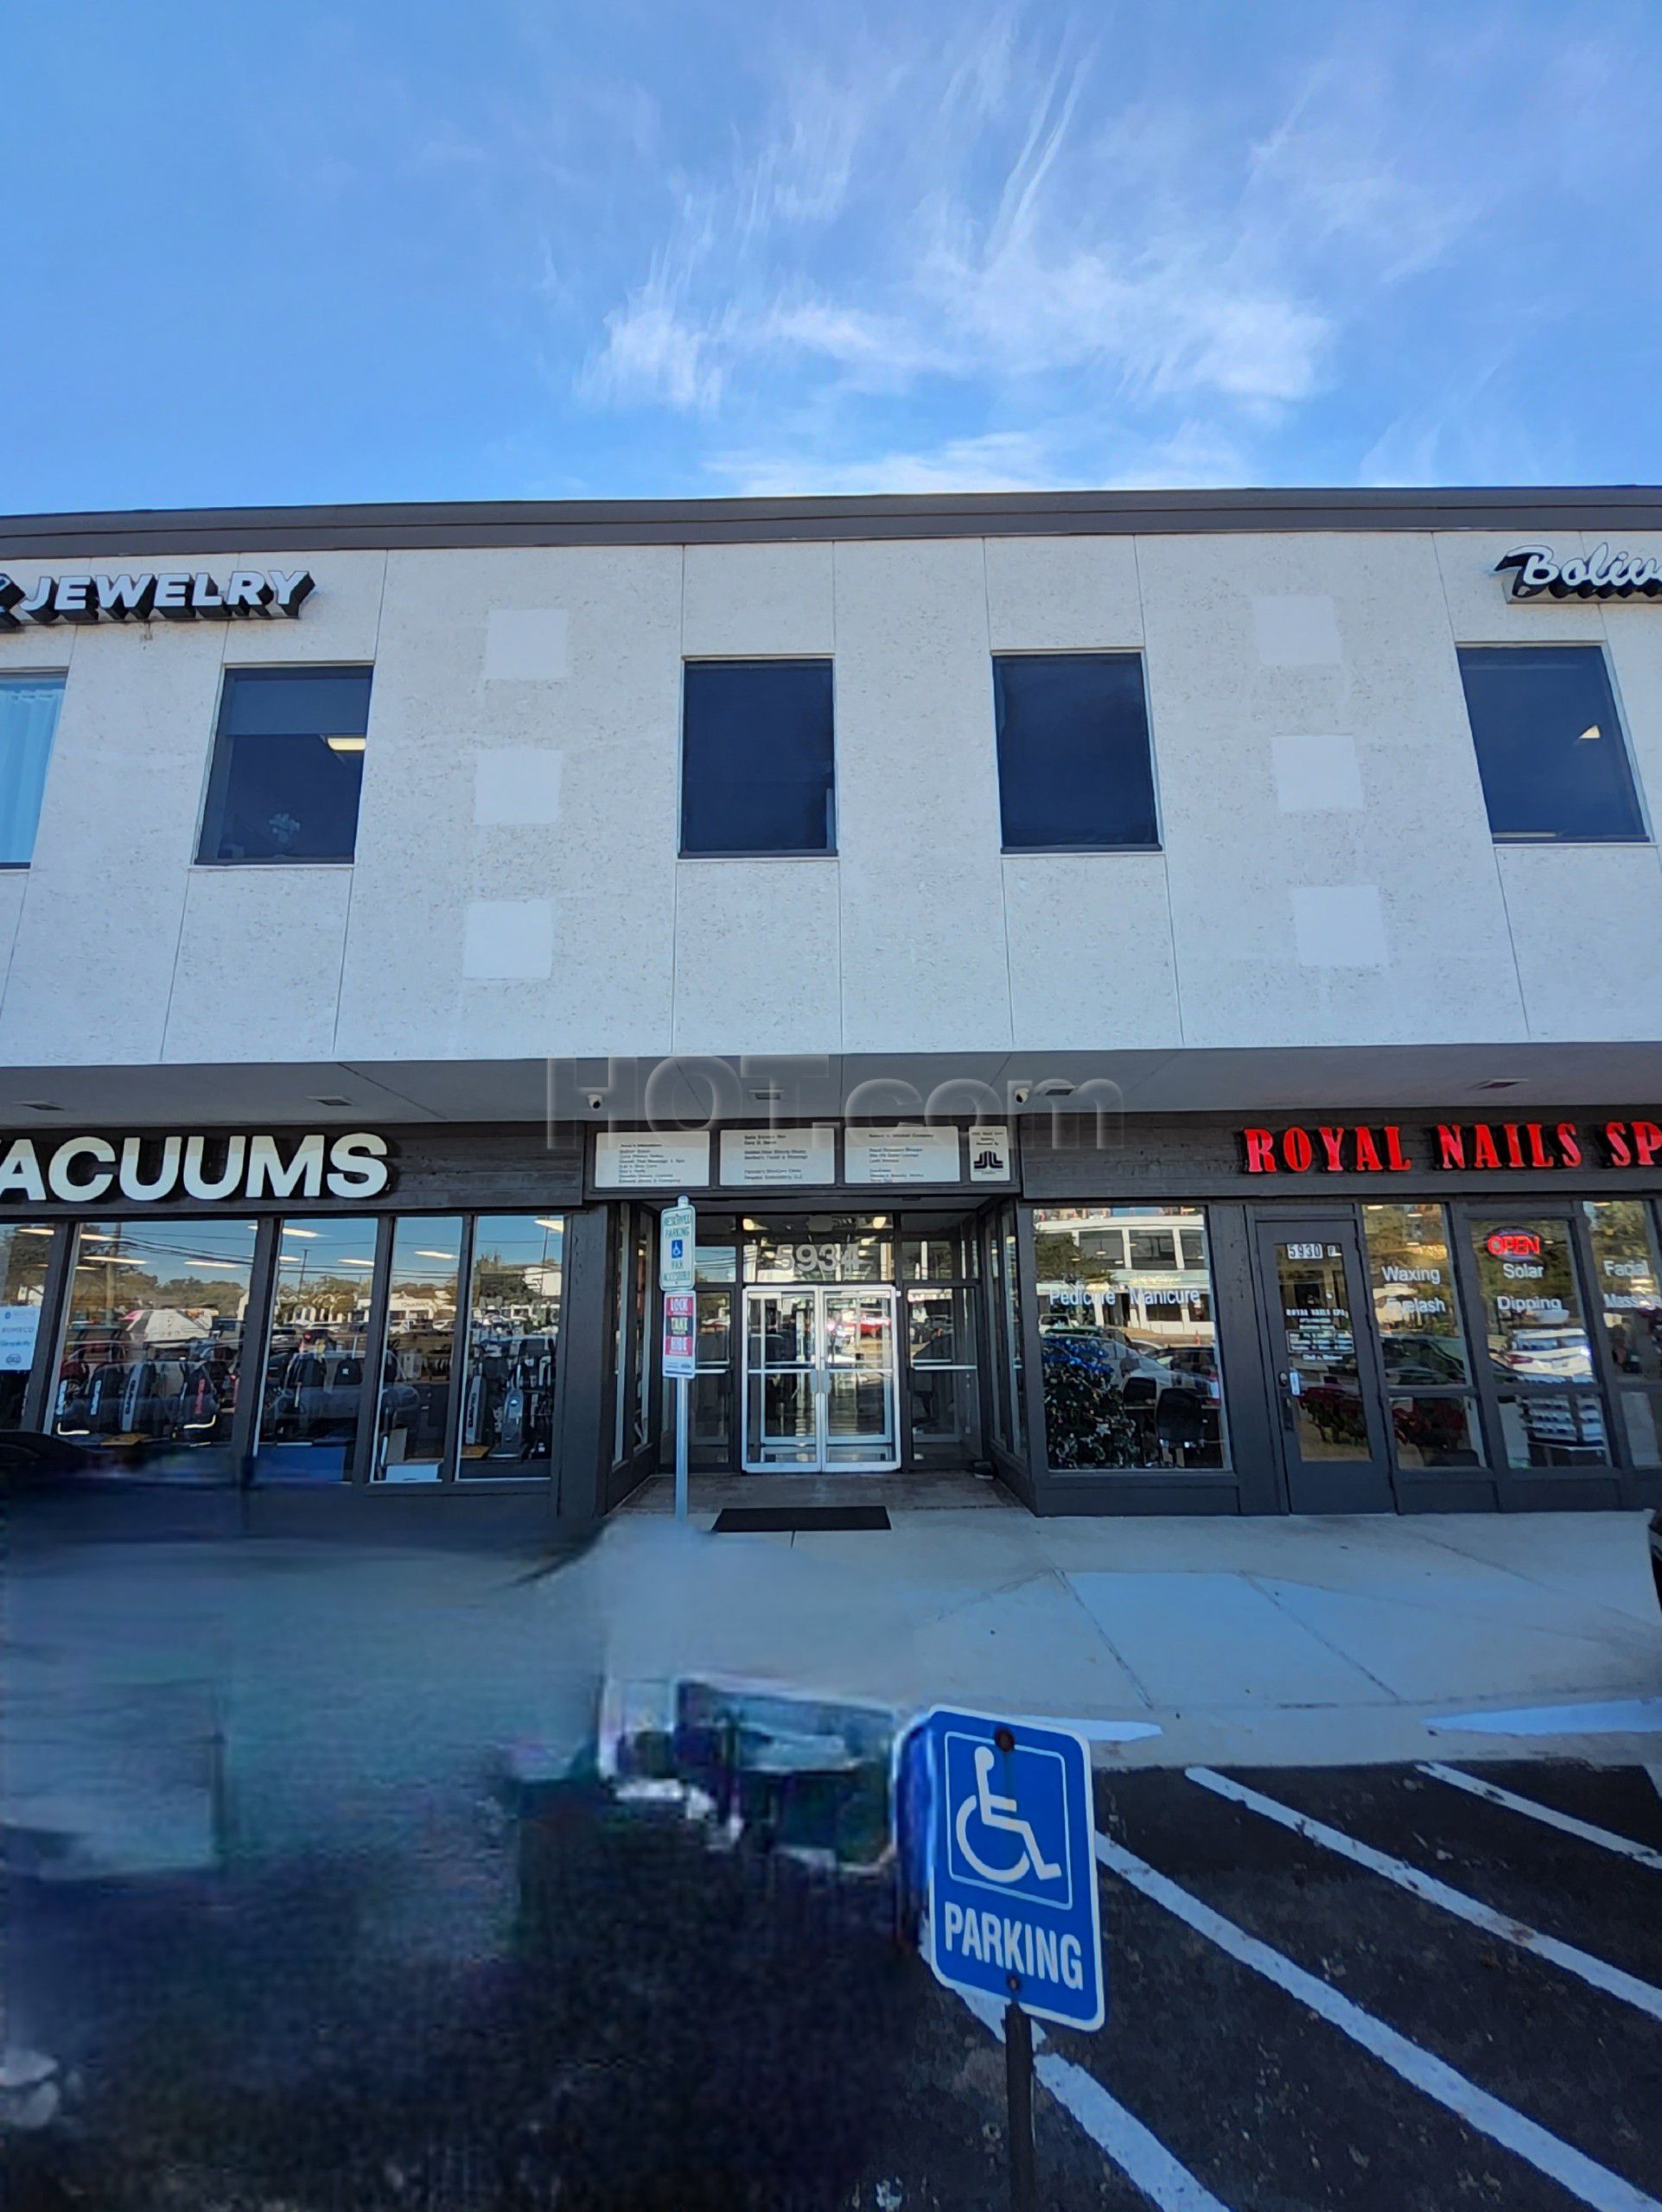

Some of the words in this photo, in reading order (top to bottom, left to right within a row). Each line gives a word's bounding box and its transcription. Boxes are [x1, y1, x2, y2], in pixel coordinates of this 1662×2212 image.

[1506, 542, 1662, 588] Boliv
[20, 570, 312, 613] JEWELRY
[1243, 1127, 1412, 1173] ROYAL
[1435, 1124, 1582, 1169] NAILS
[0, 1132, 389, 1202] ACUUMS
[1289, 1243, 1323, 1258] 5930
[1487, 1235, 1540, 1255] OPEN
[777, 1243, 863, 1272] 5934
[1382, 1266, 1441, 1286] Waxing
[1503, 1263, 1544, 1279] Solar
[1603, 1259, 1650, 1277] Facial
[1130, 1287, 1200, 1305] Manicure
[1497, 1296, 1562, 1312] Dipping
[945, 1901, 1084, 1991] PARKING
